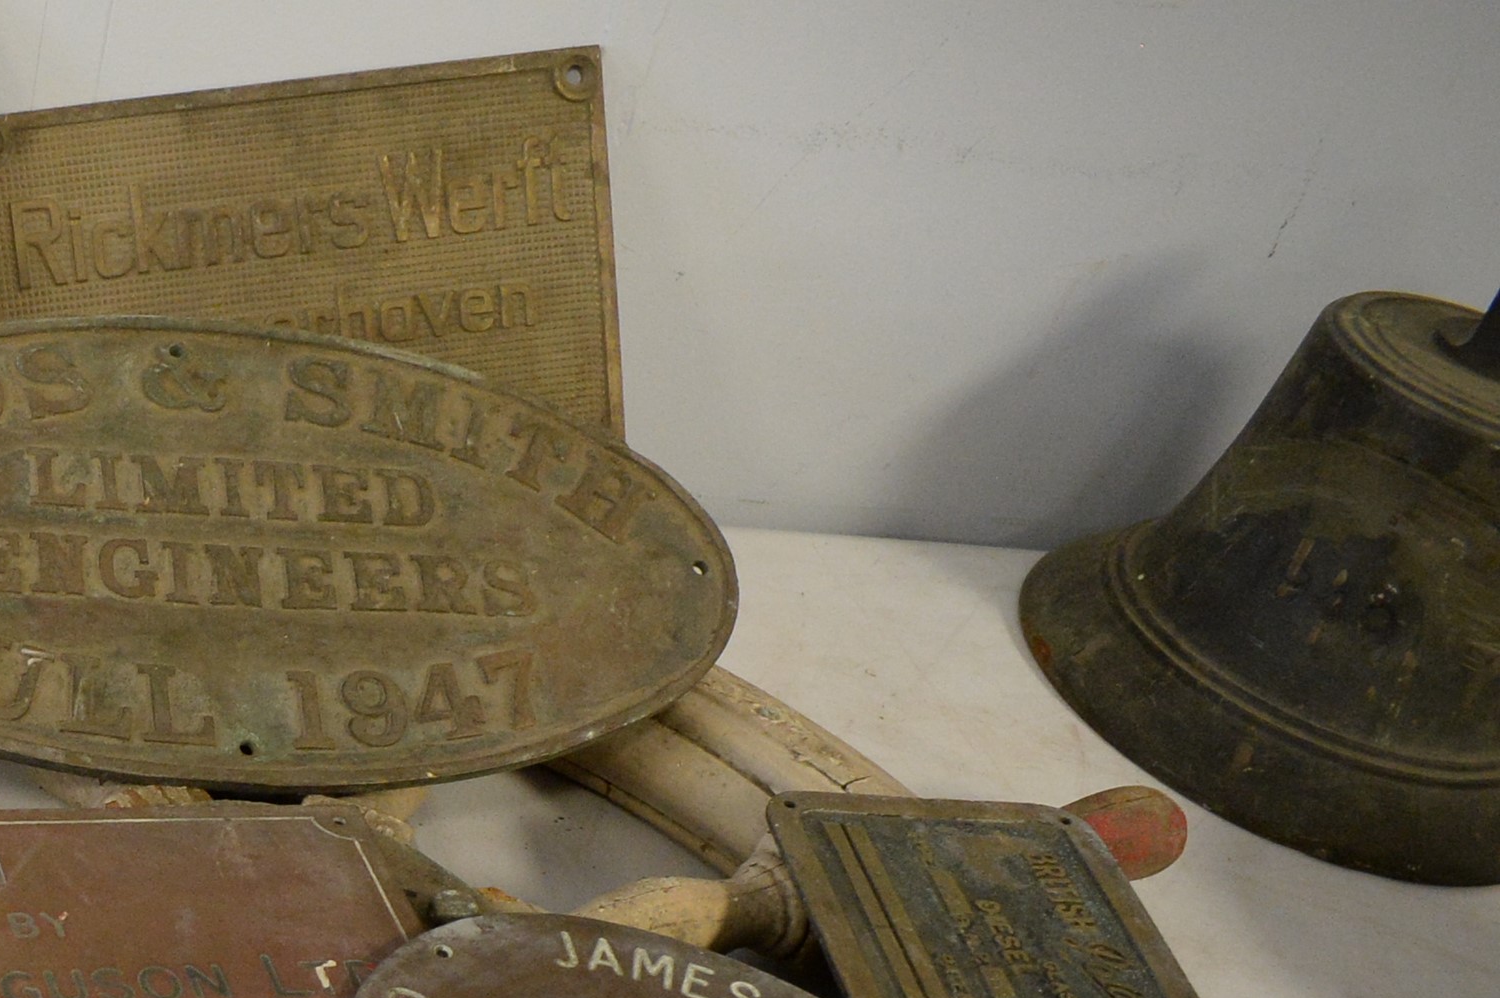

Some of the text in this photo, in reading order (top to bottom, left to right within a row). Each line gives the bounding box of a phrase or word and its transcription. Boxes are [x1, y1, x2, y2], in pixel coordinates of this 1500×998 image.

[10, 134, 574, 290] Rickmers Werft
[140, 342, 228, 414] &
[284, 355, 657, 547] SMITH
[25, 446, 440, 528] LIMITED
[289, 648, 546, 751] 1947
[6, 910, 70, 941] BY
[1028, 851, 1099, 935] BRITISH
[977, 899, 1036, 977] DIESEL
